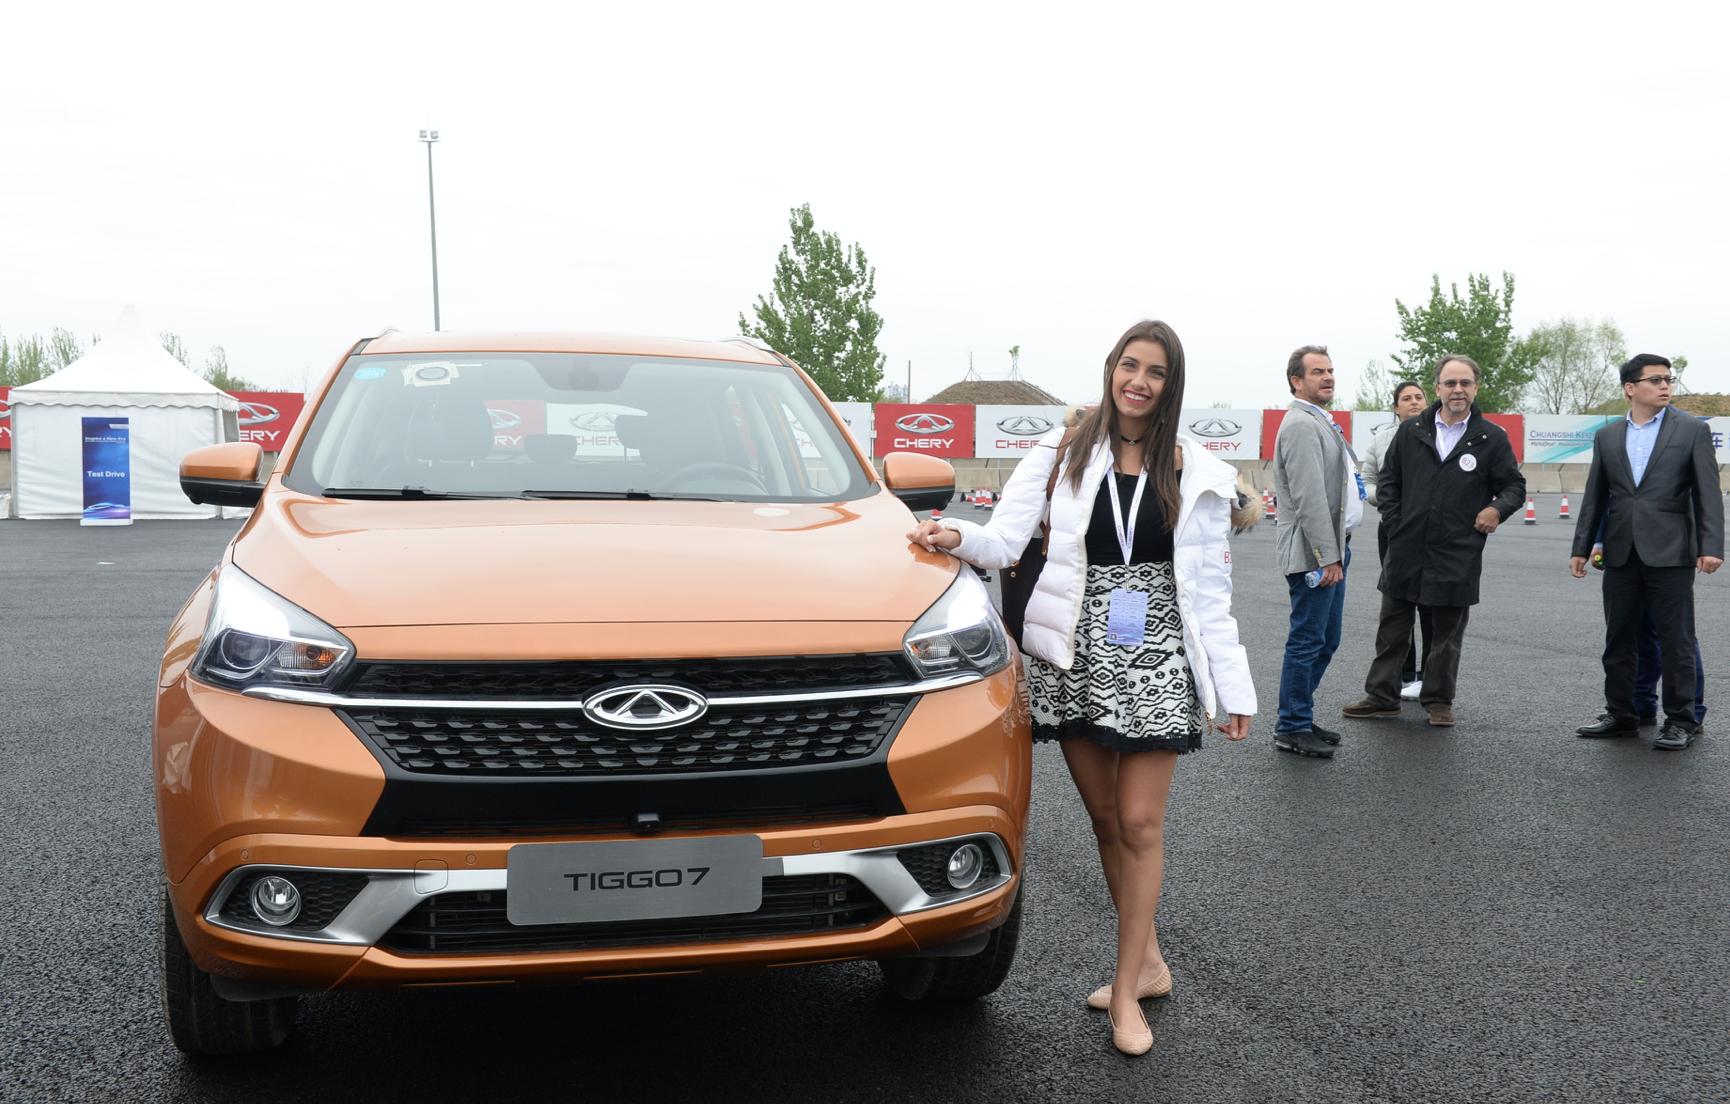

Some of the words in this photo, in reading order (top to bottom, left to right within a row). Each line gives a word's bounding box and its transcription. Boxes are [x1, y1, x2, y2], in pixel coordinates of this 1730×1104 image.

[239, 430, 281, 441] ERY
[576, 435, 621, 447] HER
[894, 438, 955, 449] CHERY
[995, 439, 1041, 449] CHER
[1200, 441, 1242, 451] HERY
[87, 470, 104, 478] Test
[105, 470, 126, 478] Drive
[564, 869, 682, 891] TIGGO
[687, 867, 710, 885] 7
